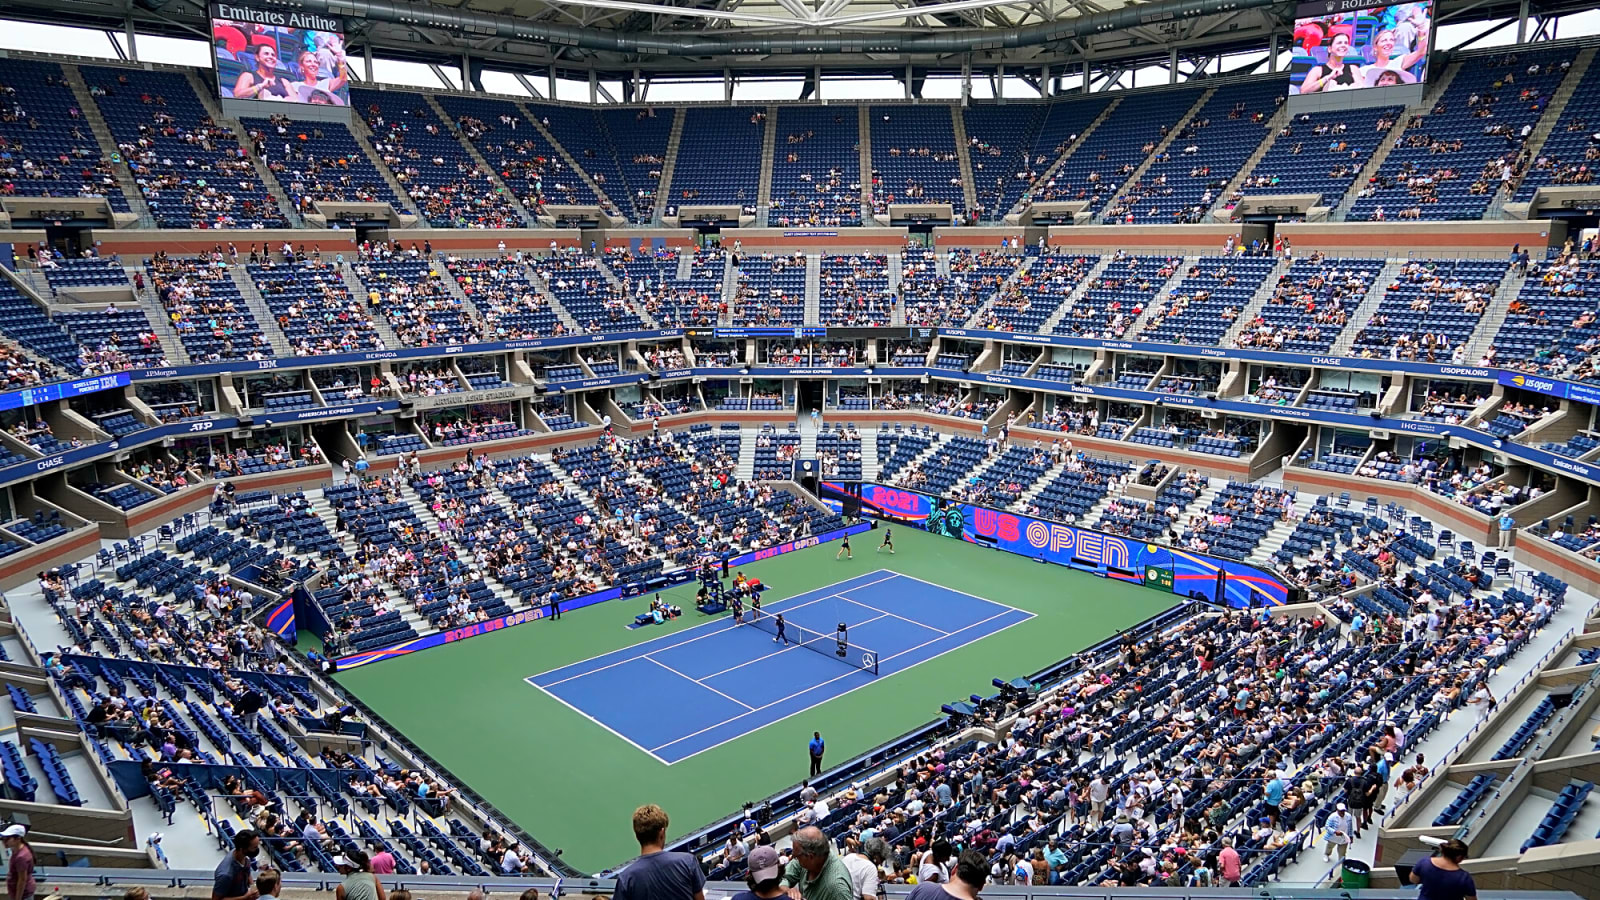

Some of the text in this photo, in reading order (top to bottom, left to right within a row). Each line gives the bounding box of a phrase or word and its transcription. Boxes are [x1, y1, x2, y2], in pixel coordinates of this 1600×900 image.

[219, 4, 337, 31] Emirates Airline
[258, 360, 278, 368] IBM
[1312, 357, 1341, 366] CHASE
[145, 369, 178, 377] J.P.Morgan
[1440, 367, 1489, 377] USOPEN.ORG
[100, 376, 118, 389] IBM
[1525, 379, 1553, 391] us open
[298, 407, 354, 418] AMERICAN EXPRESS
[190, 421, 213, 432] ATP
[1401, 422, 1417, 430] IHG
[37, 456, 64, 470] CHASE
[1553, 458, 1588, 475] Emirates Airline
[873, 486, 919, 512] 2021
[975, 508, 1129, 568] US OPEN
[755, 536, 819, 560] 2021 US OPEN
[444, 608, 544, 643] 2021 US OPEN
